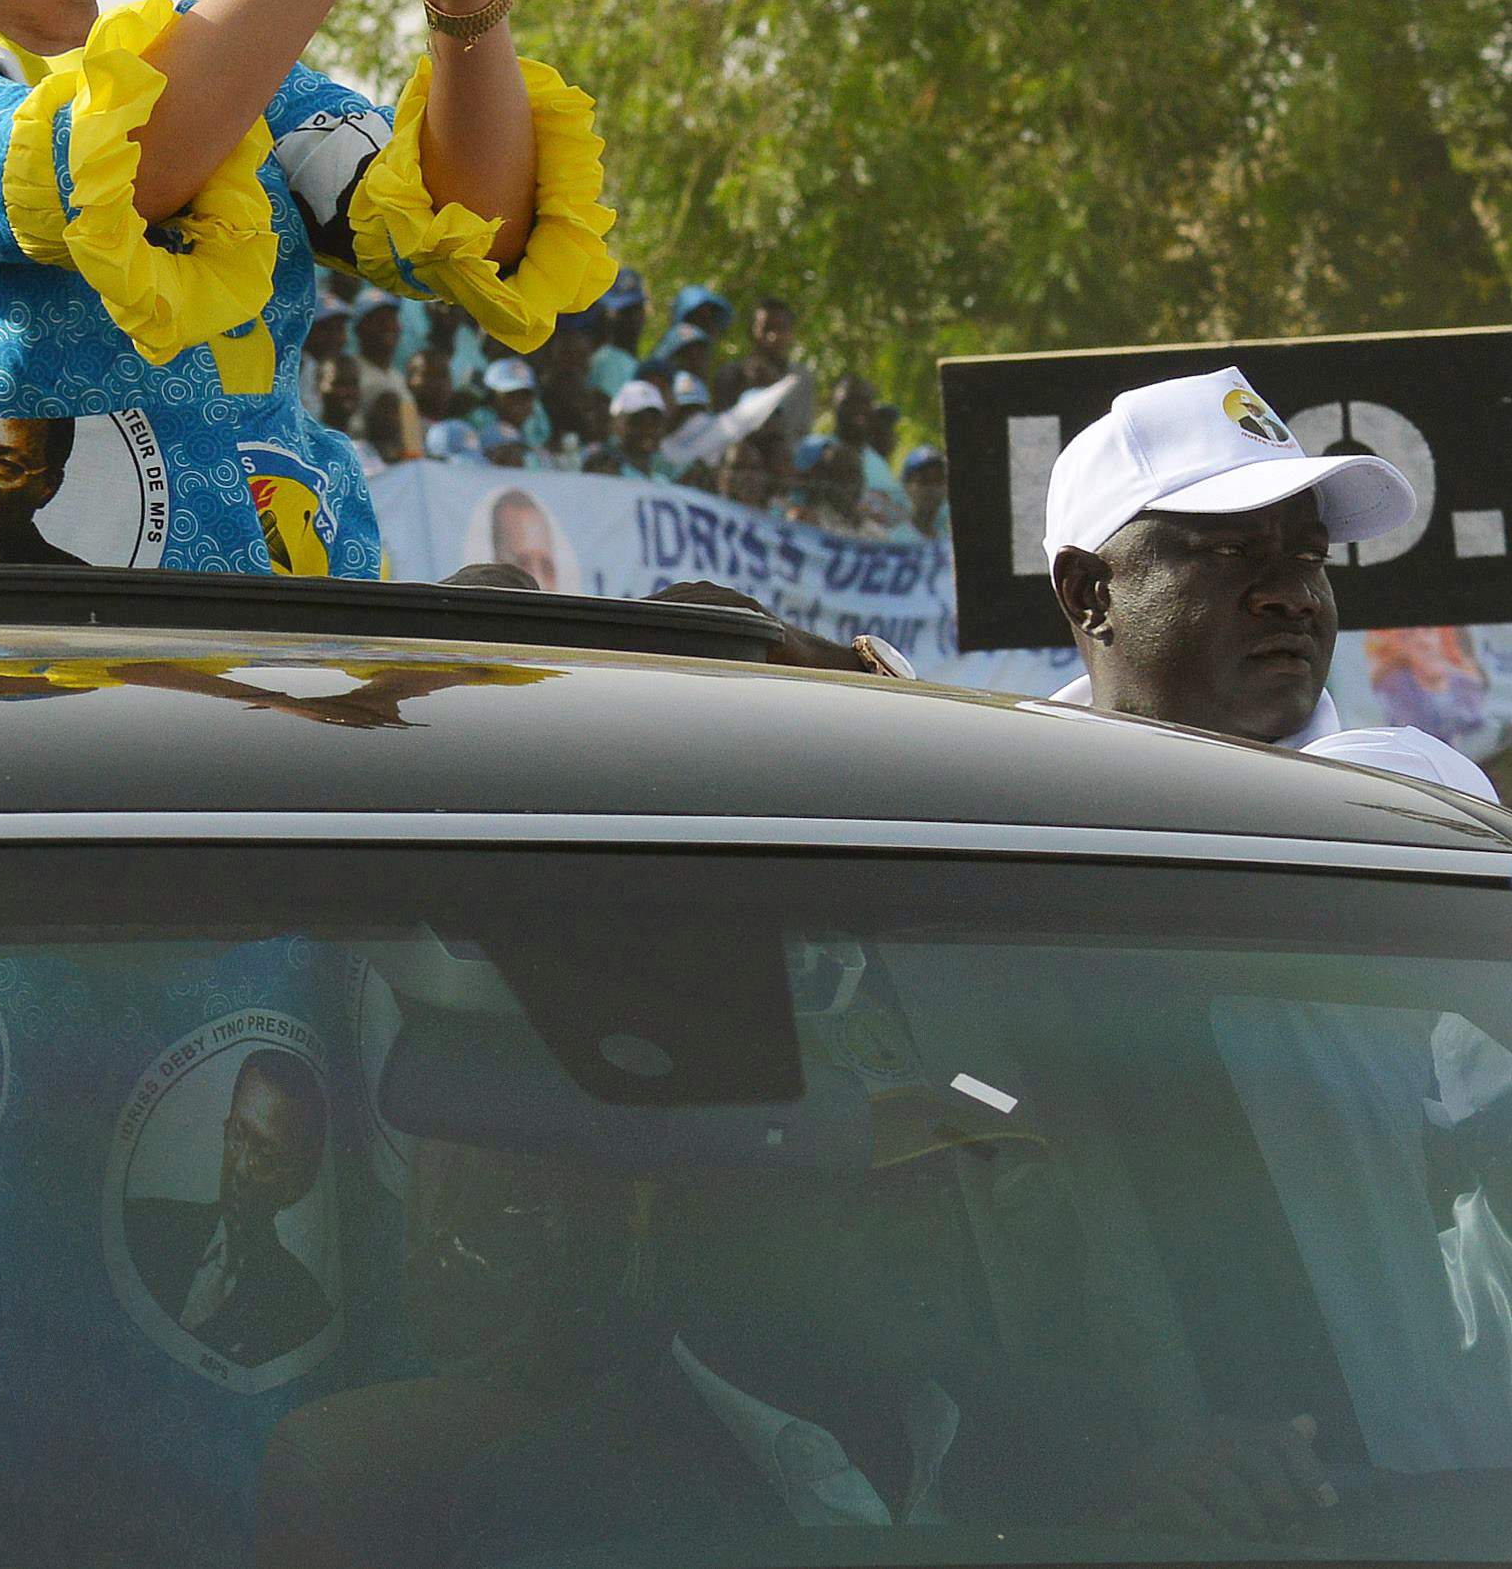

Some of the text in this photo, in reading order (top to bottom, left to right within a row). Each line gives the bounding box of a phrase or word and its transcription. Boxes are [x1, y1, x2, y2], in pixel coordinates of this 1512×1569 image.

[146, 466, 165, 492] DE
[147, 501, 166, 544] MPS
[636, 498, 805, 585] IDRISS
[159, 1038, 207, 1078] DEBY
[211, 1017, 245, 1044] ITNO
